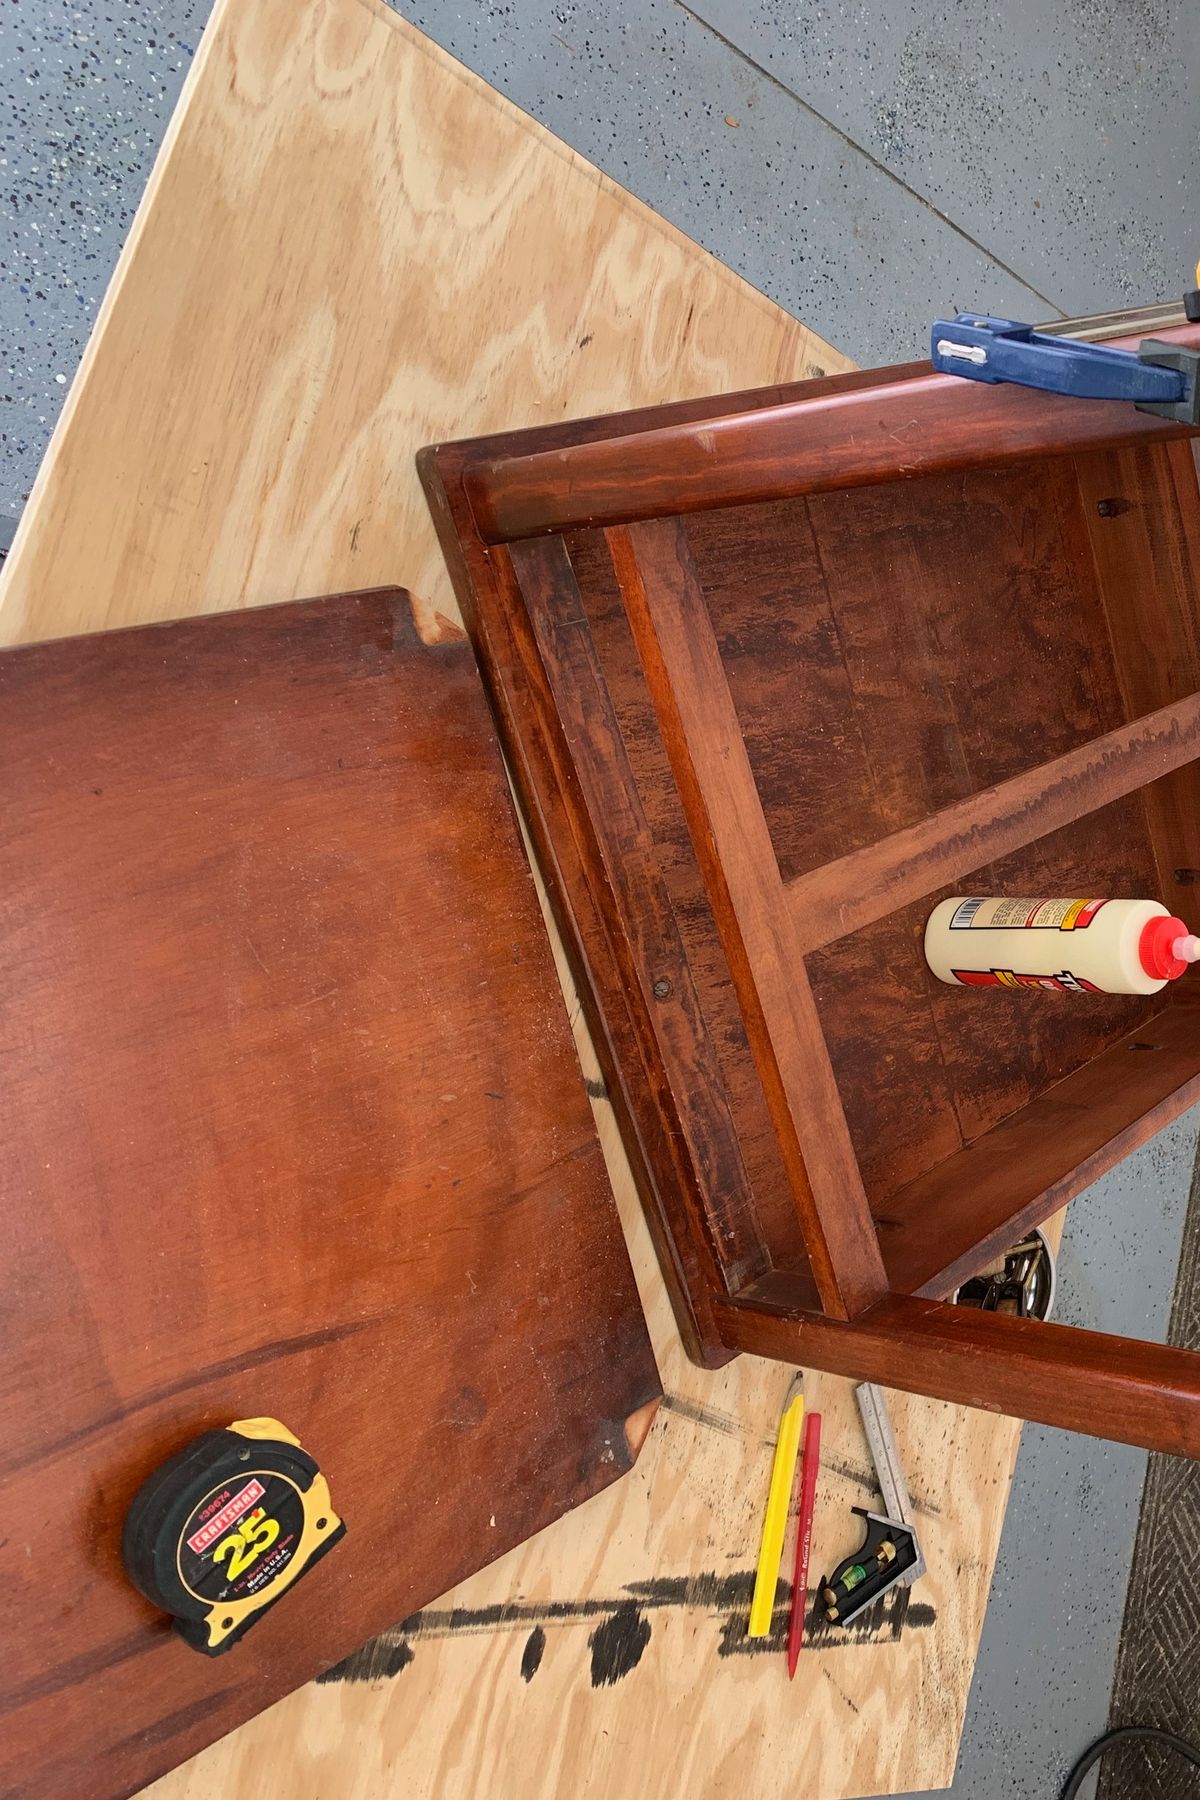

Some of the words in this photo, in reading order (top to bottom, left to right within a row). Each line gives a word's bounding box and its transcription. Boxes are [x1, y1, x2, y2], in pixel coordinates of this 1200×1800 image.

[196, 1486, 259, 1548] CRAFTSMAN
[803, 1530, 811, 1542] Stic
[213, 1507, 281, 1582] 25
[247, 1572, 264, 1588] Made
[269, 1549, 289, 1566] U.S.A.
